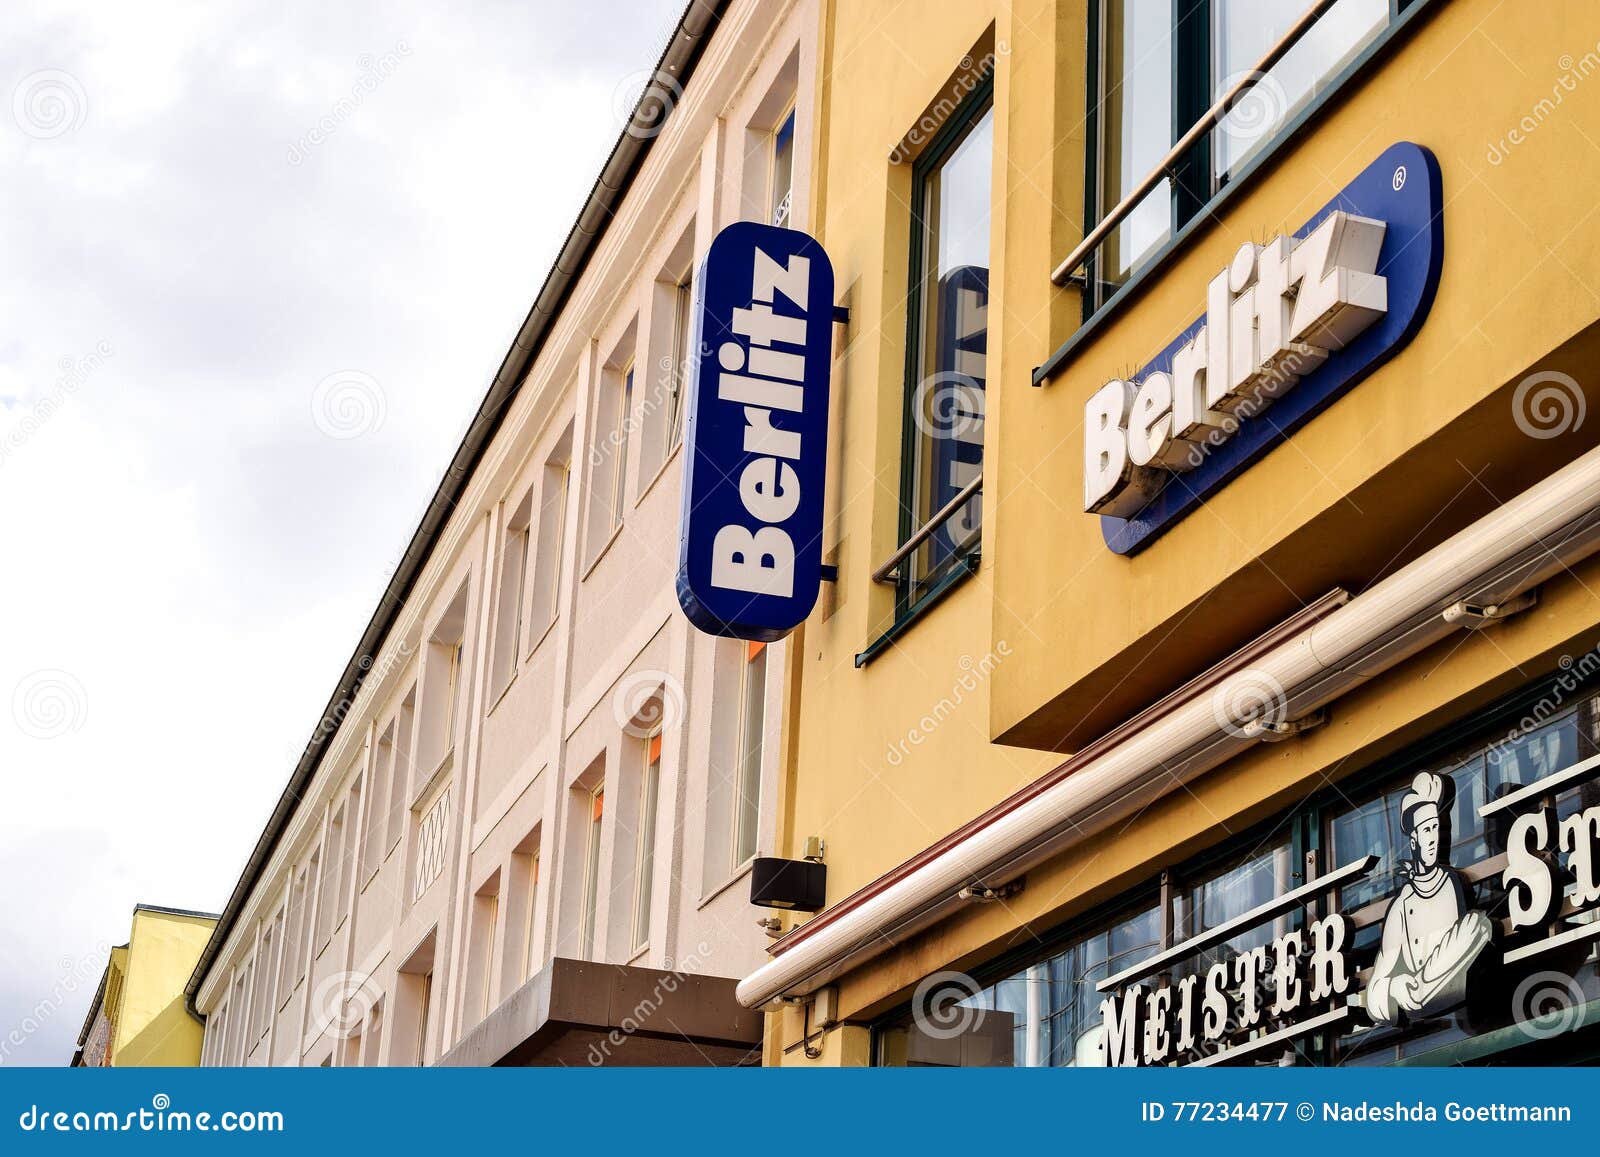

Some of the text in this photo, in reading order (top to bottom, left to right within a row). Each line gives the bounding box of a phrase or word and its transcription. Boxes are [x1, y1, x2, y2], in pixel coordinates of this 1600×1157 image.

[711, 246, 811, 598] Berlitz
[1084, 210, 1387, 514] Berlitz
[1099, 913, 1349, 1067] MEISTER
